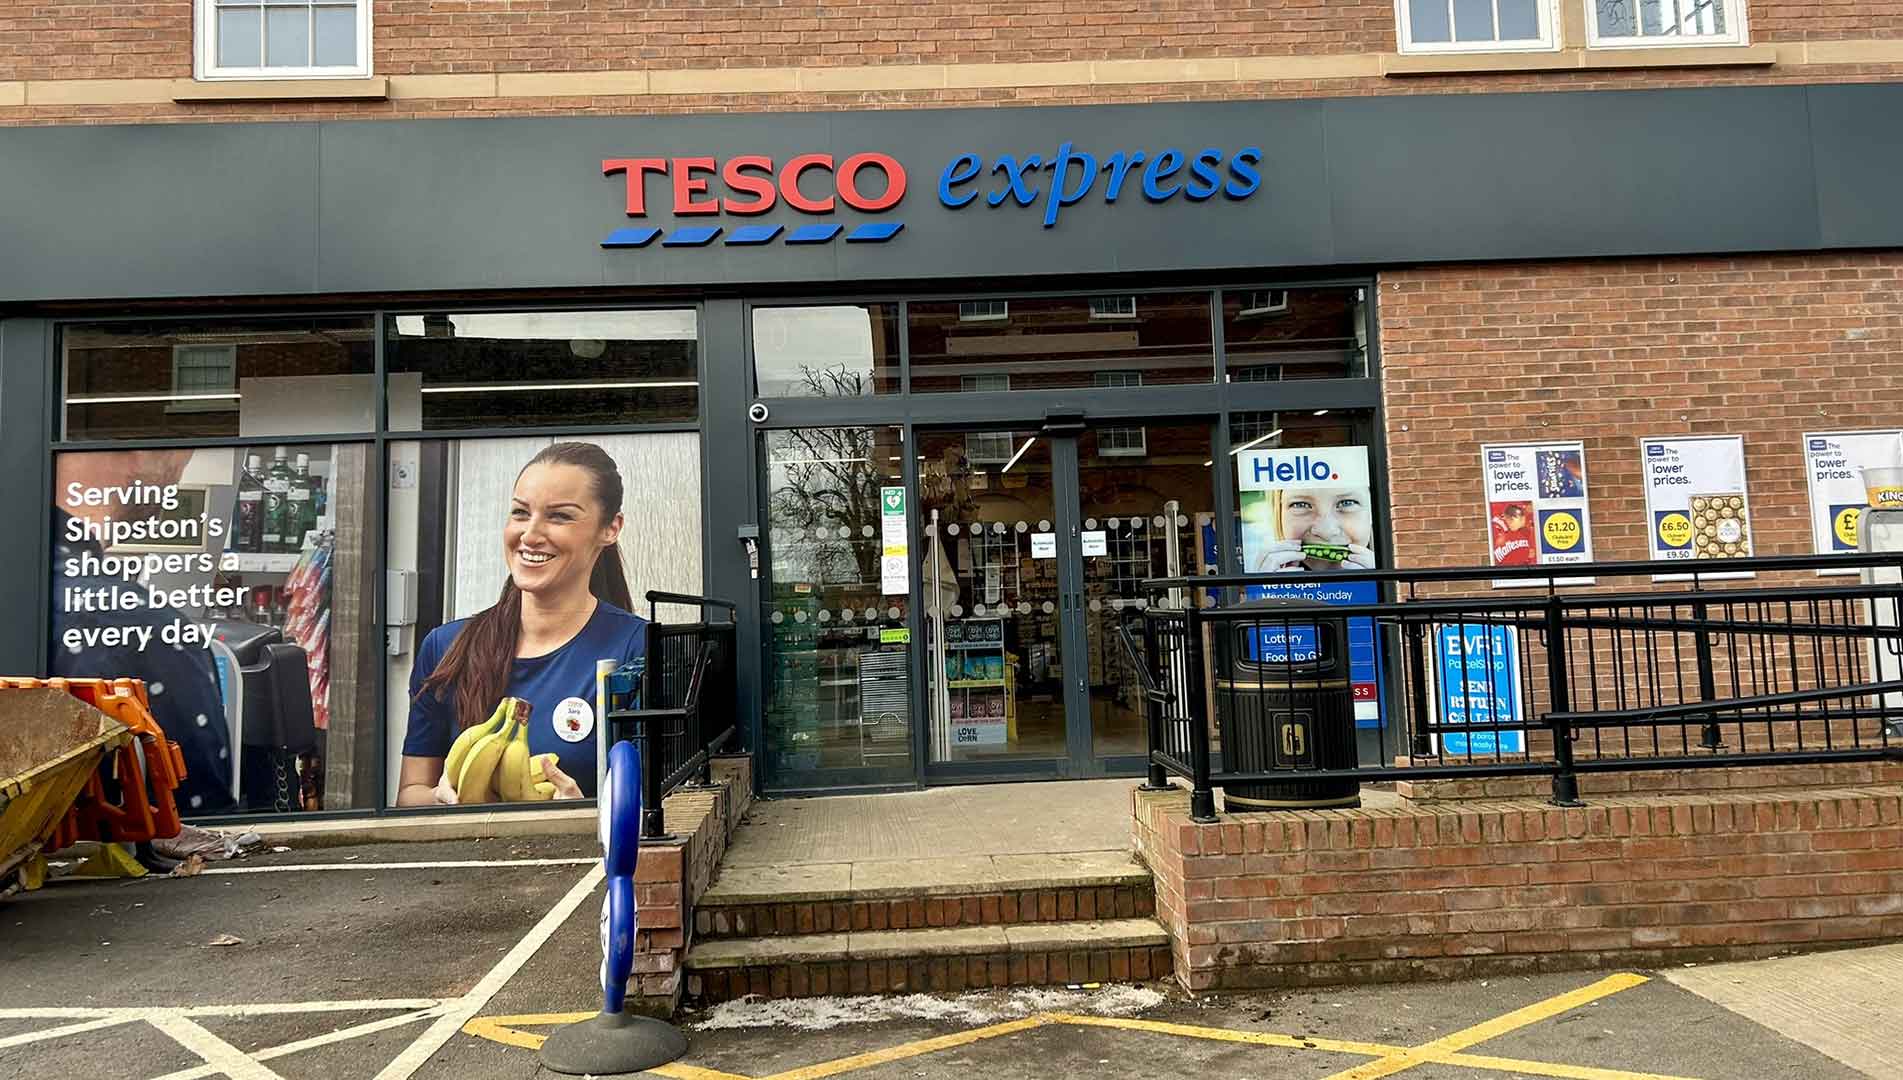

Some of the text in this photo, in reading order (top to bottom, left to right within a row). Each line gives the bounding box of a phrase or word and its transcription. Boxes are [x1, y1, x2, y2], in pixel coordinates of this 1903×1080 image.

[602, 142, 1263, 227] TESCO express
[1253, 456, 1338, 482] Hello.
[1652, 464, 1684, 474] lower
[1815, 459, 1847, 468] lower
[1494, 470, 1525, 480] lower
[1653, 475, 1692, 488] prices.
[1495, 481, 1533, 493] prices.
[66, 480, 178, 510] Serving
[65, 513, 223, 545] Shipston's
[1548, 522, 1576, 532] £1.20
[1662, 522, 1689, 531] £6.50
[1667, 551, 1689, 559] £9.50
[64, 552, 239, 581] shoppers a
[64, 584, 250, 612] little better
[1303, 591, 1314, 600] to
[1317, 589, 1352, 602] Sunday
[63, 624, 152, 651] every
[1294, 652, 1305, 661] to
